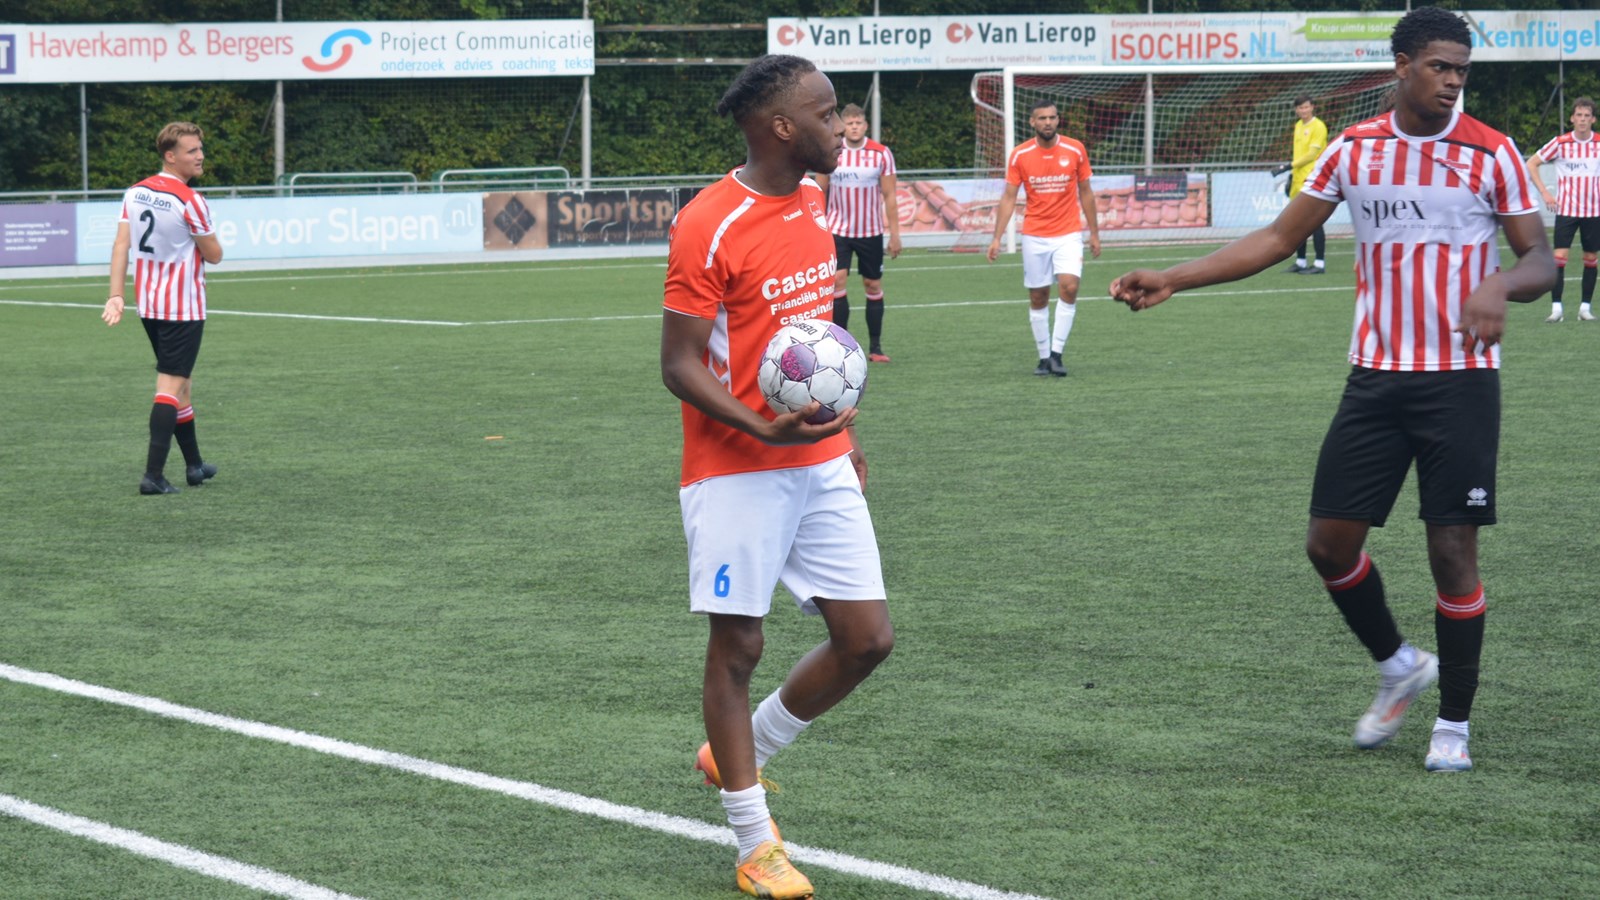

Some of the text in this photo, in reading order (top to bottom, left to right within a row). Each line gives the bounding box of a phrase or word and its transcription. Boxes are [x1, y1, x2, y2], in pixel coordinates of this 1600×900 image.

[809, 23, 932, 49] Van Lierop
[977, 21, 1096, 47] Van Lierop
[1311, 22, 1396, 34] Kruipruimte isolat
[29, 29, 293, 62] Haverkamp & Bergers
[381, 31, 593, 55] Project Communicatie
[1111, 32, 1284, 60] ISOCHIPS.NL
[381, 57, 593, 72] onderzoek advies coaching tekst
[1028, 173, 1070, 184] Cascade
[1361, 199, 1426, 228] spex
[138, 209, 155, 254] 2
[247, 216, 319, 246] voor
[327, 207, 439, 251] Slapen
[761, 253, 837, 300] Cascad
[714, 564, 730, 598] 6
